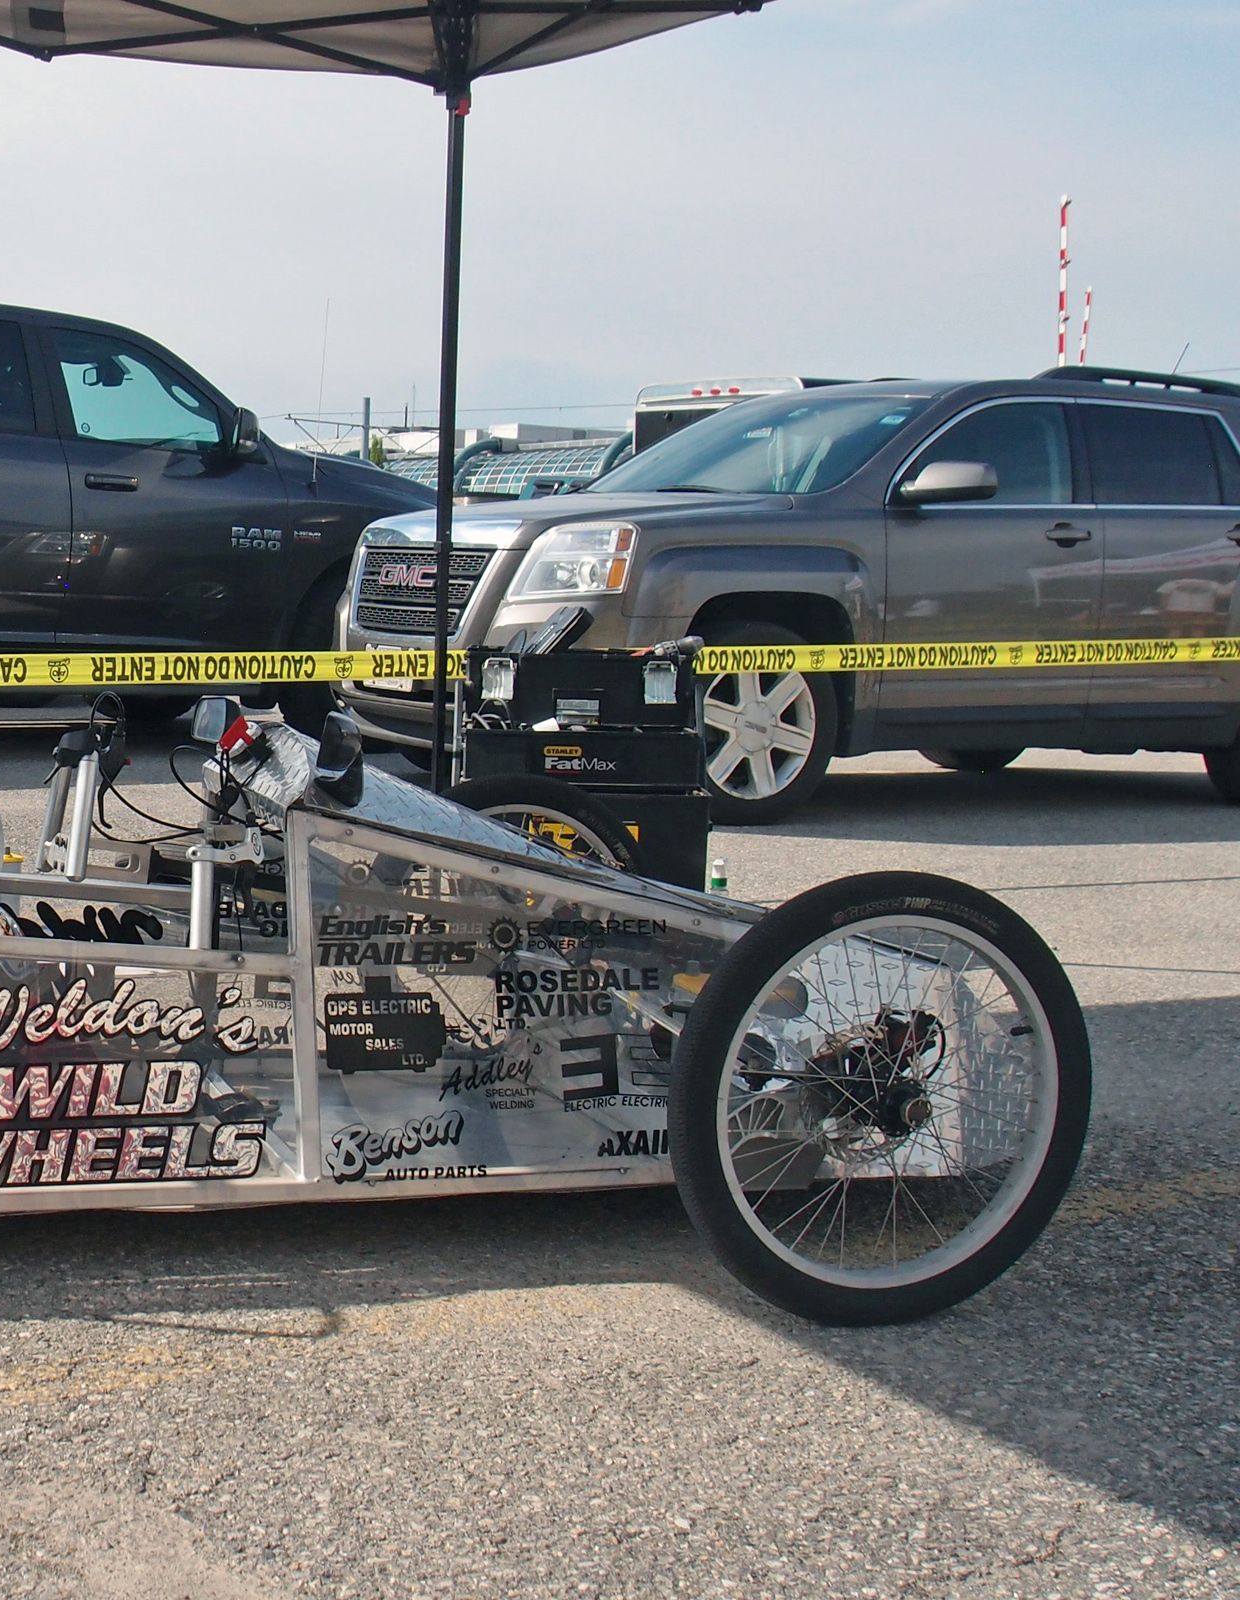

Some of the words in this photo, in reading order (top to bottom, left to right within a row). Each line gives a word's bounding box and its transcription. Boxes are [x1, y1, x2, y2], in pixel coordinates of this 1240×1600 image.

[231, 527, 282, 540] RAM
[231, 538, 281, 551] 1500
[378, 565, 437, 587] GMC
[731, 648, 796, 670] CAUTION
[839, 647, 884, 669] ENTER
[887, 646, 916, 668] NOT
[918, 646, 935, 667] DO
[937, 645, 997, 667] CAUTION
[1035, 644, 1077, 665] ENTER
[1124, 641, 1178, 660] CAUTION
[1211, 639, 1240, 658] NTER
[90, 656, 155, 682] ENTER
[160, 656, 199, 681] NOT
[204, 655, 230, 681] DO
[234, 654, 316, 680] CAUTION
[372, 654, 429, 678] ENTER
[708, 649, 728, 671] DO
[545, 757, 616, 771] FatMax
[319, 914, 447, 941] English's
[526, 919, 667, 937] EVERGREEN
[317, 941, 477, 966] TRAILERS
[528, 939, 577, 950] POWER
[495, 968, 659, 993] ROSEDALE
[362, 999, 432, 1016] ELECTRIC
[497, 992, 612, 1018] PAVING
[329, 1022, 374, 1036] MOTOR
[497, 1018, 530, 1030] LTD.
[365, 1038, 405, 1051] SALES
[401, 1054, 428, 1066] LTD.
[485, 1088, 537, 1098] SPECIALTY
[490, 1100, 535, 1111] WELDING
[564, 1096, 617, 1112] ELECTRIC
[326, 1110, 464, 1185] Benson
[385, 1166, 429, 1181] AUTO
[434, 1165, 487, 1180] PARTS
